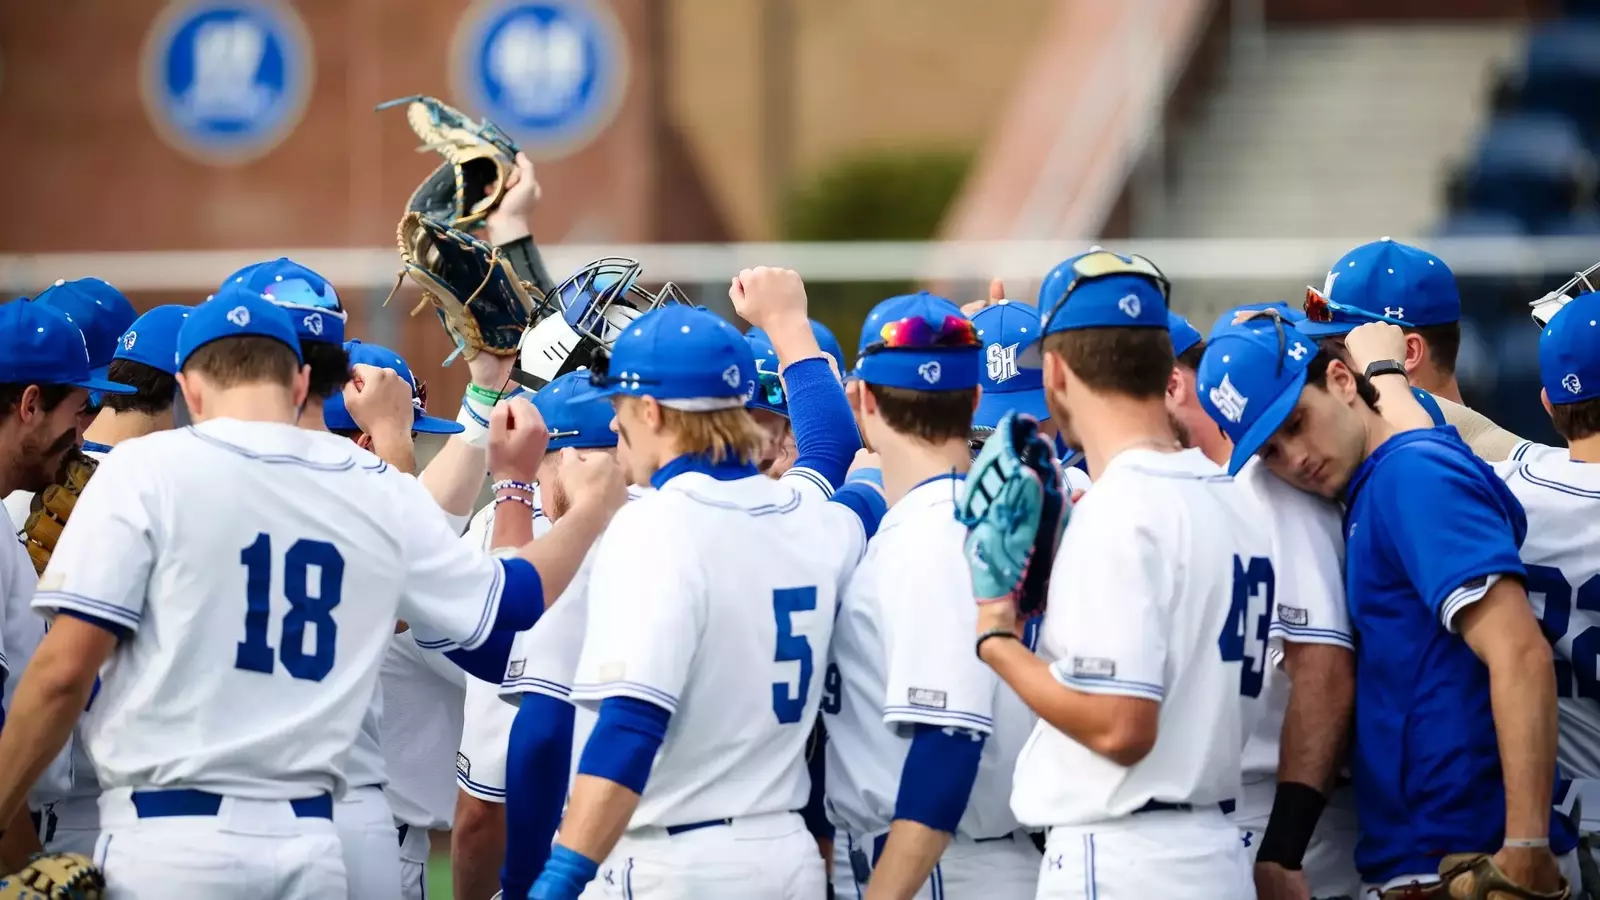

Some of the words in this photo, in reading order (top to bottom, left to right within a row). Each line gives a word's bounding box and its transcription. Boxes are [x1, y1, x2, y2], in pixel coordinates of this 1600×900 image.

[986, 342, 1021, 385] SH
[1209, 372, 1249, 423] SH
[234, 531, 345, 682] 18
[1218, 553, 1275, 699] 43
[772, 586, 817, 724] 5
[819, 662, 842, 715] 9
